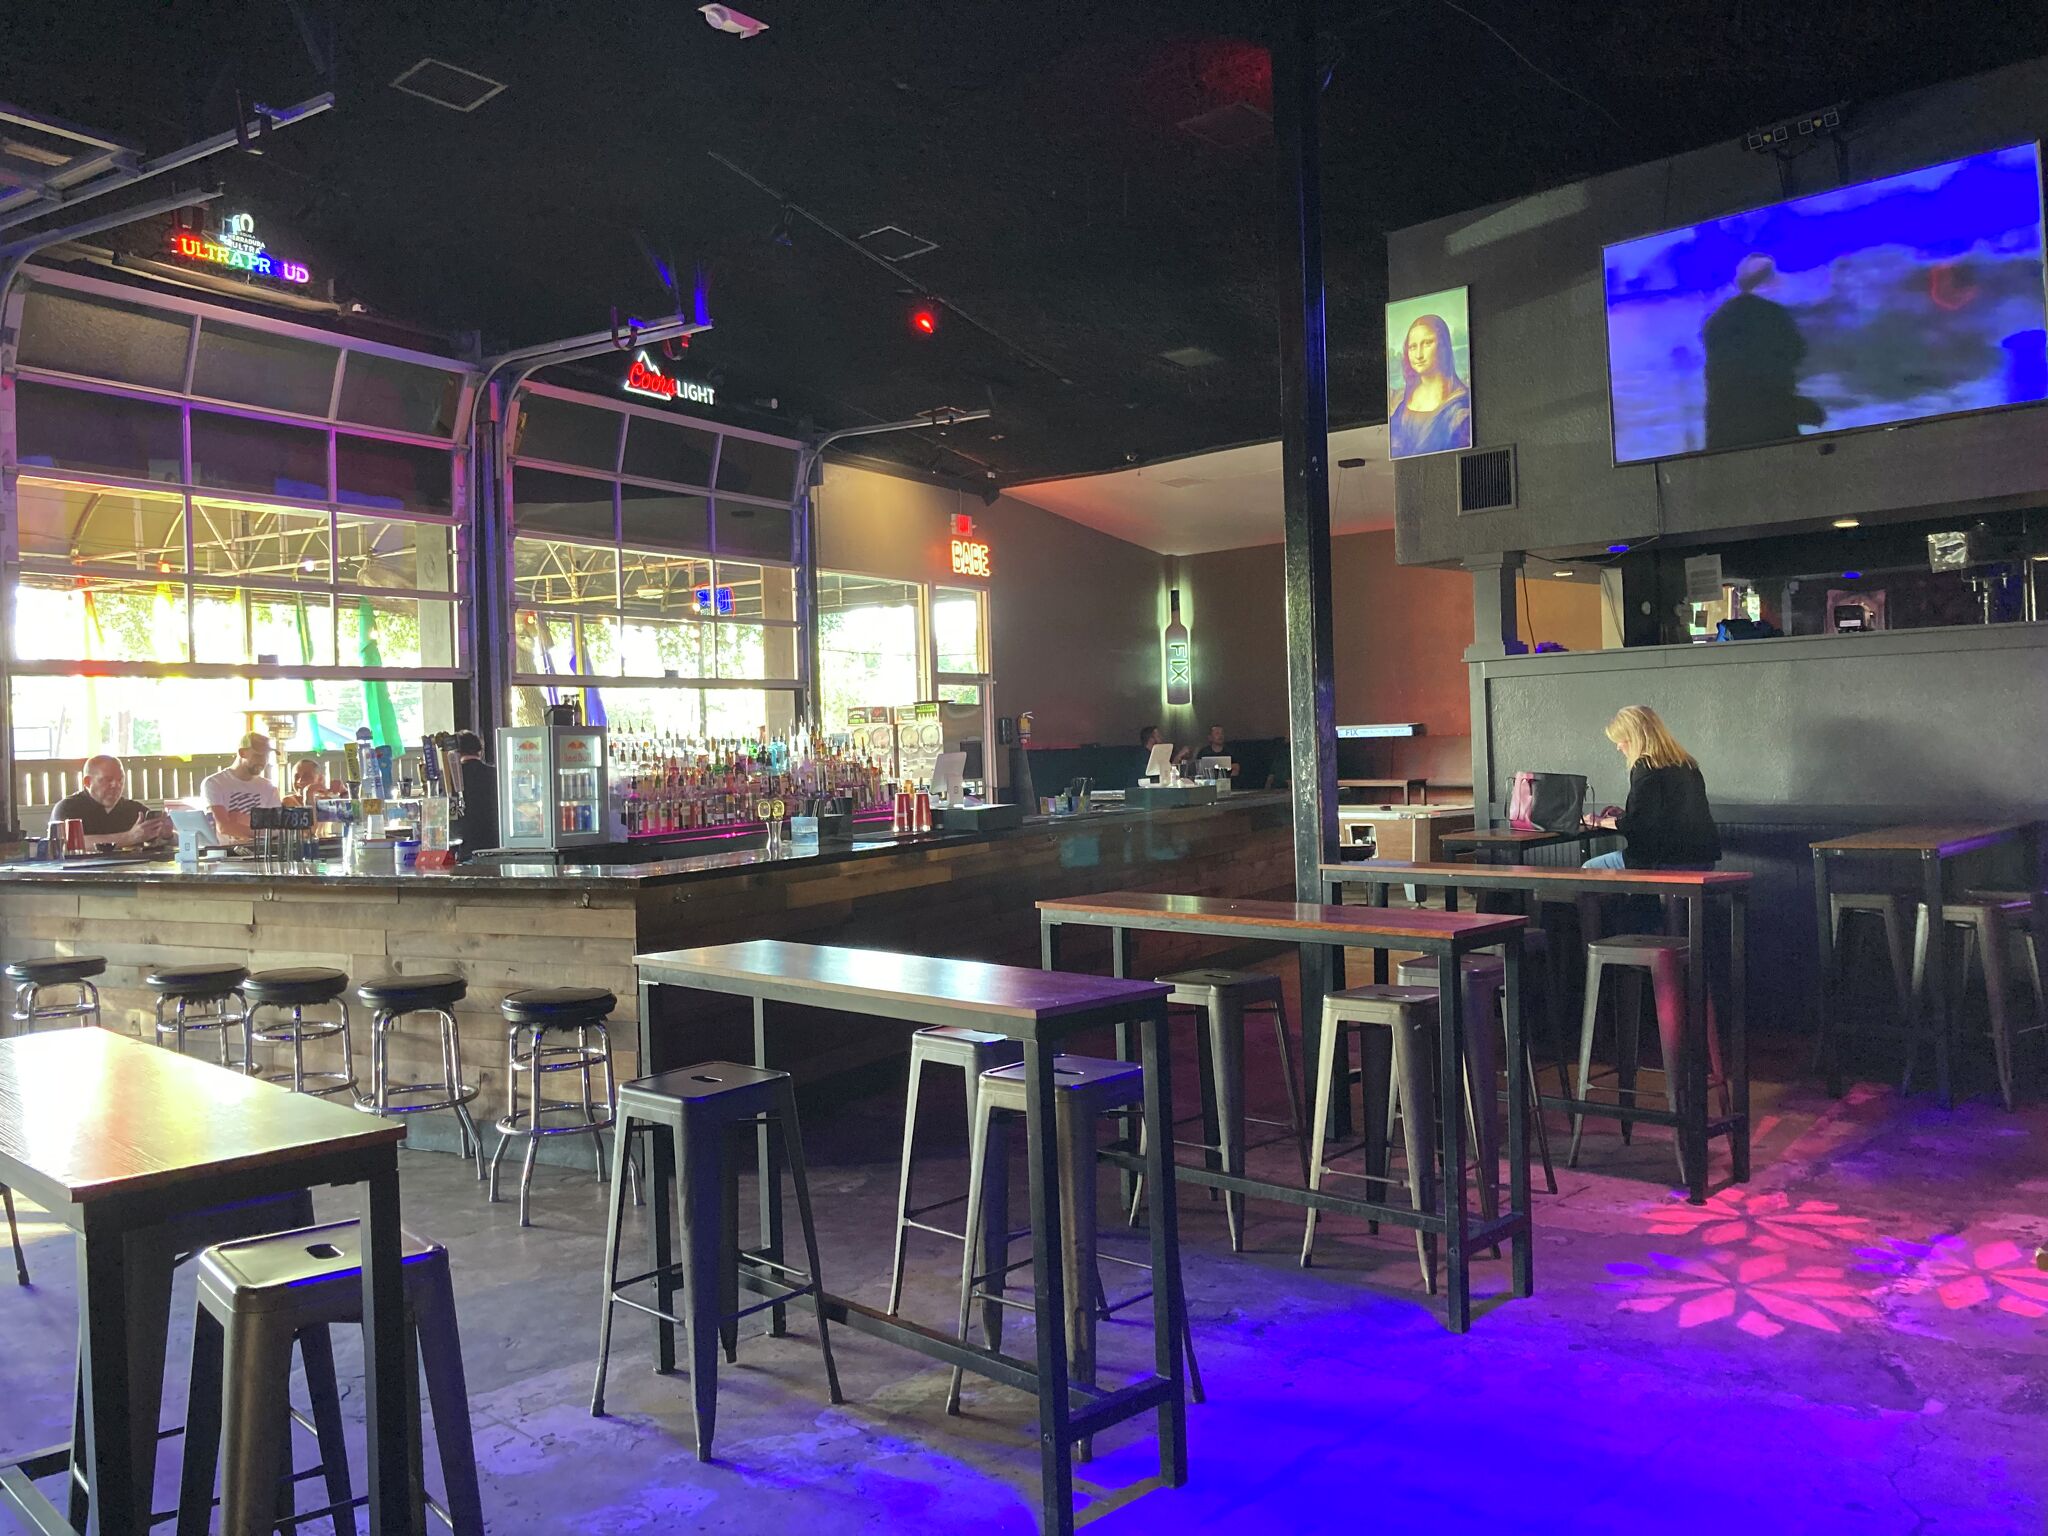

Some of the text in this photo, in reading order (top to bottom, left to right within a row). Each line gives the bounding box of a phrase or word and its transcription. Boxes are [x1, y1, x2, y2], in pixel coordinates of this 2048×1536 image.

[180, 238, 245, 267] ULTRA
[629, 361, 715, 405] Coors LIGHT
[1170, 642, 1189, 685] FIX
[1345, 728, 1359, 737] FIX
